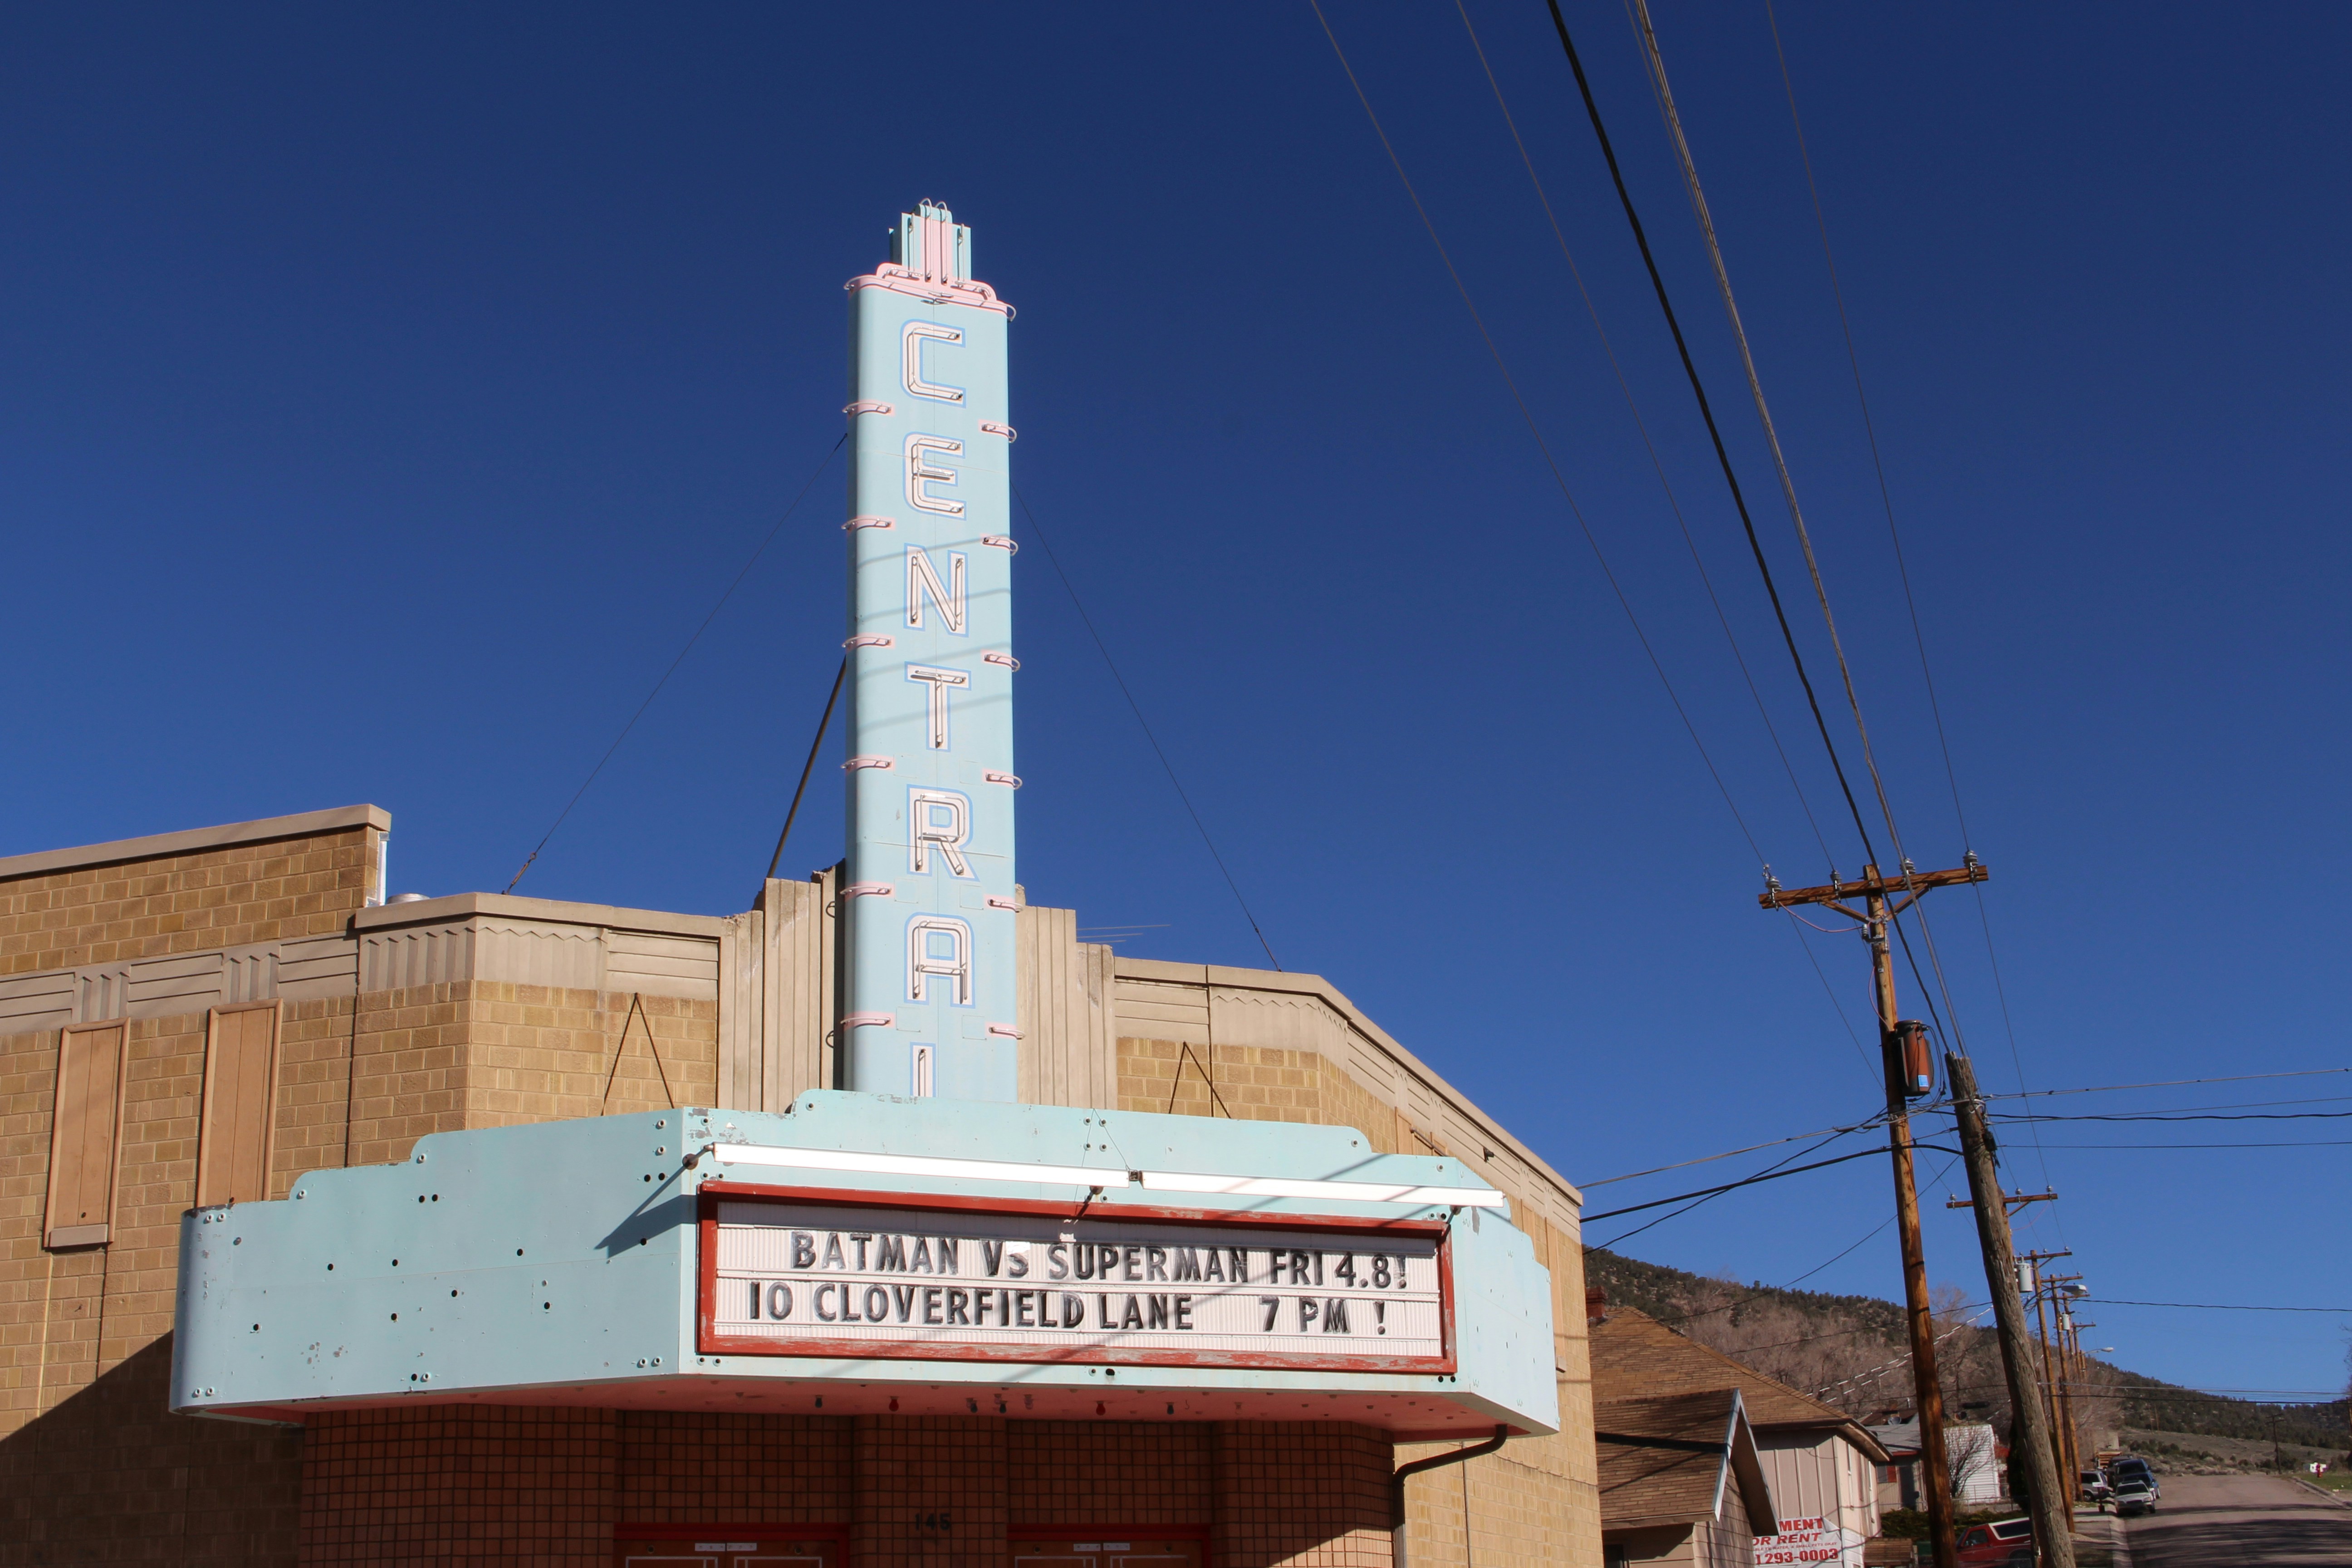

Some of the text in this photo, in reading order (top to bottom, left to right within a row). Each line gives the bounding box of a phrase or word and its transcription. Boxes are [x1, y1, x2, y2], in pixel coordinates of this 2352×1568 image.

[790, 1230, 959, 1275] BATMAN
[1048, 1243, 1248, 1283] SUPERMAN
[1269, 1248, 1323, 1286] FRI
[1334, 1252, 1406, 1289] 4.8!
[813, 1283, 1085, 1328] CLOVERFIELD
[1099, 1292, 1193, 1330] LANE
[1259, 1297, 1281, 1332] 7
[1299, 1298, 1351, 1333] PM
[915, 1513, 951, 1531] 145
[1777, 1532, 1822, 1544] RENT
[1764, 1548, 1838, 1564] 293-0003
